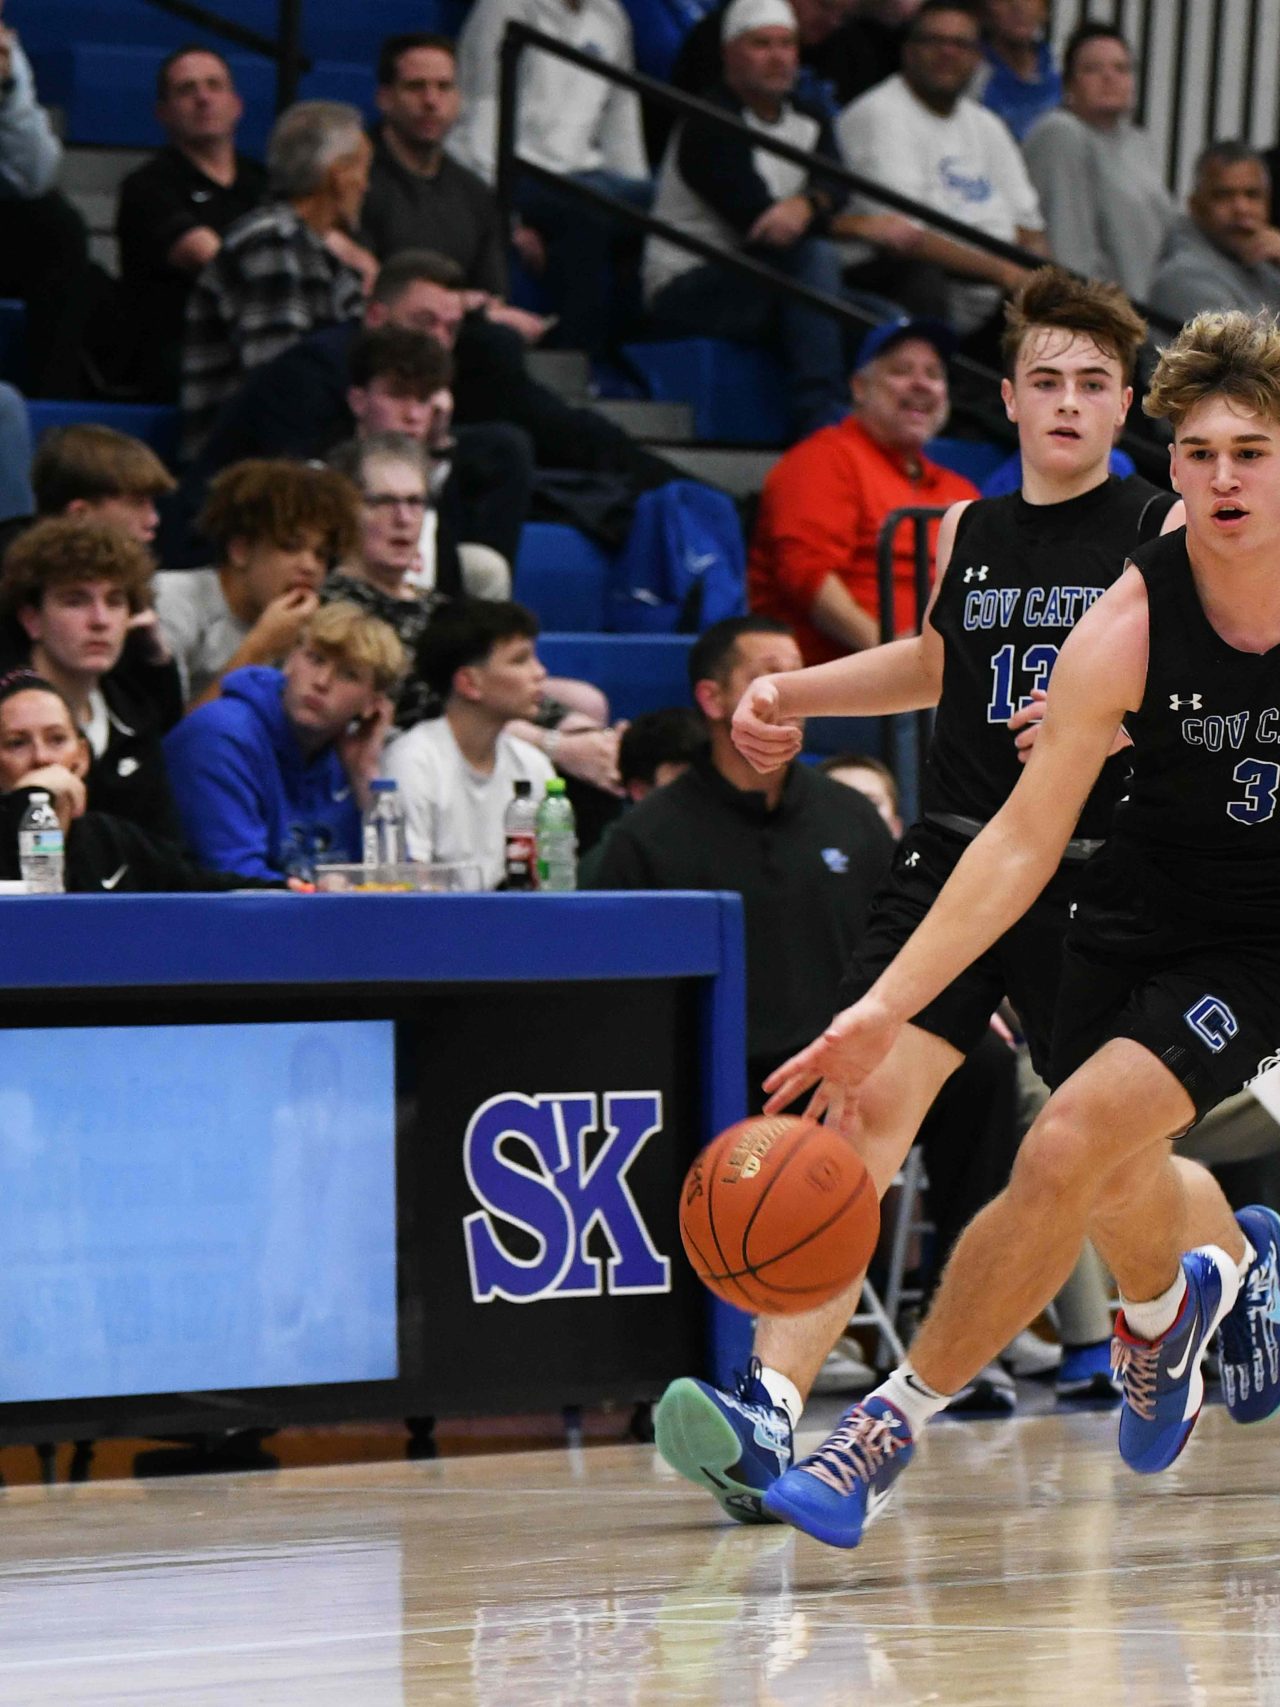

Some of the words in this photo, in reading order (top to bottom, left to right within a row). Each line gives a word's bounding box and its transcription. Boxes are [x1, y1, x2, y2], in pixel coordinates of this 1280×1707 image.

[963, 589, 1021, 631] COV
[987, 644, 1060, 723] 13
[1182, 711, 1250, 752] COV
[1226, 757, 1280, 826] 3
[463, 1090, 671, 1304] SK
